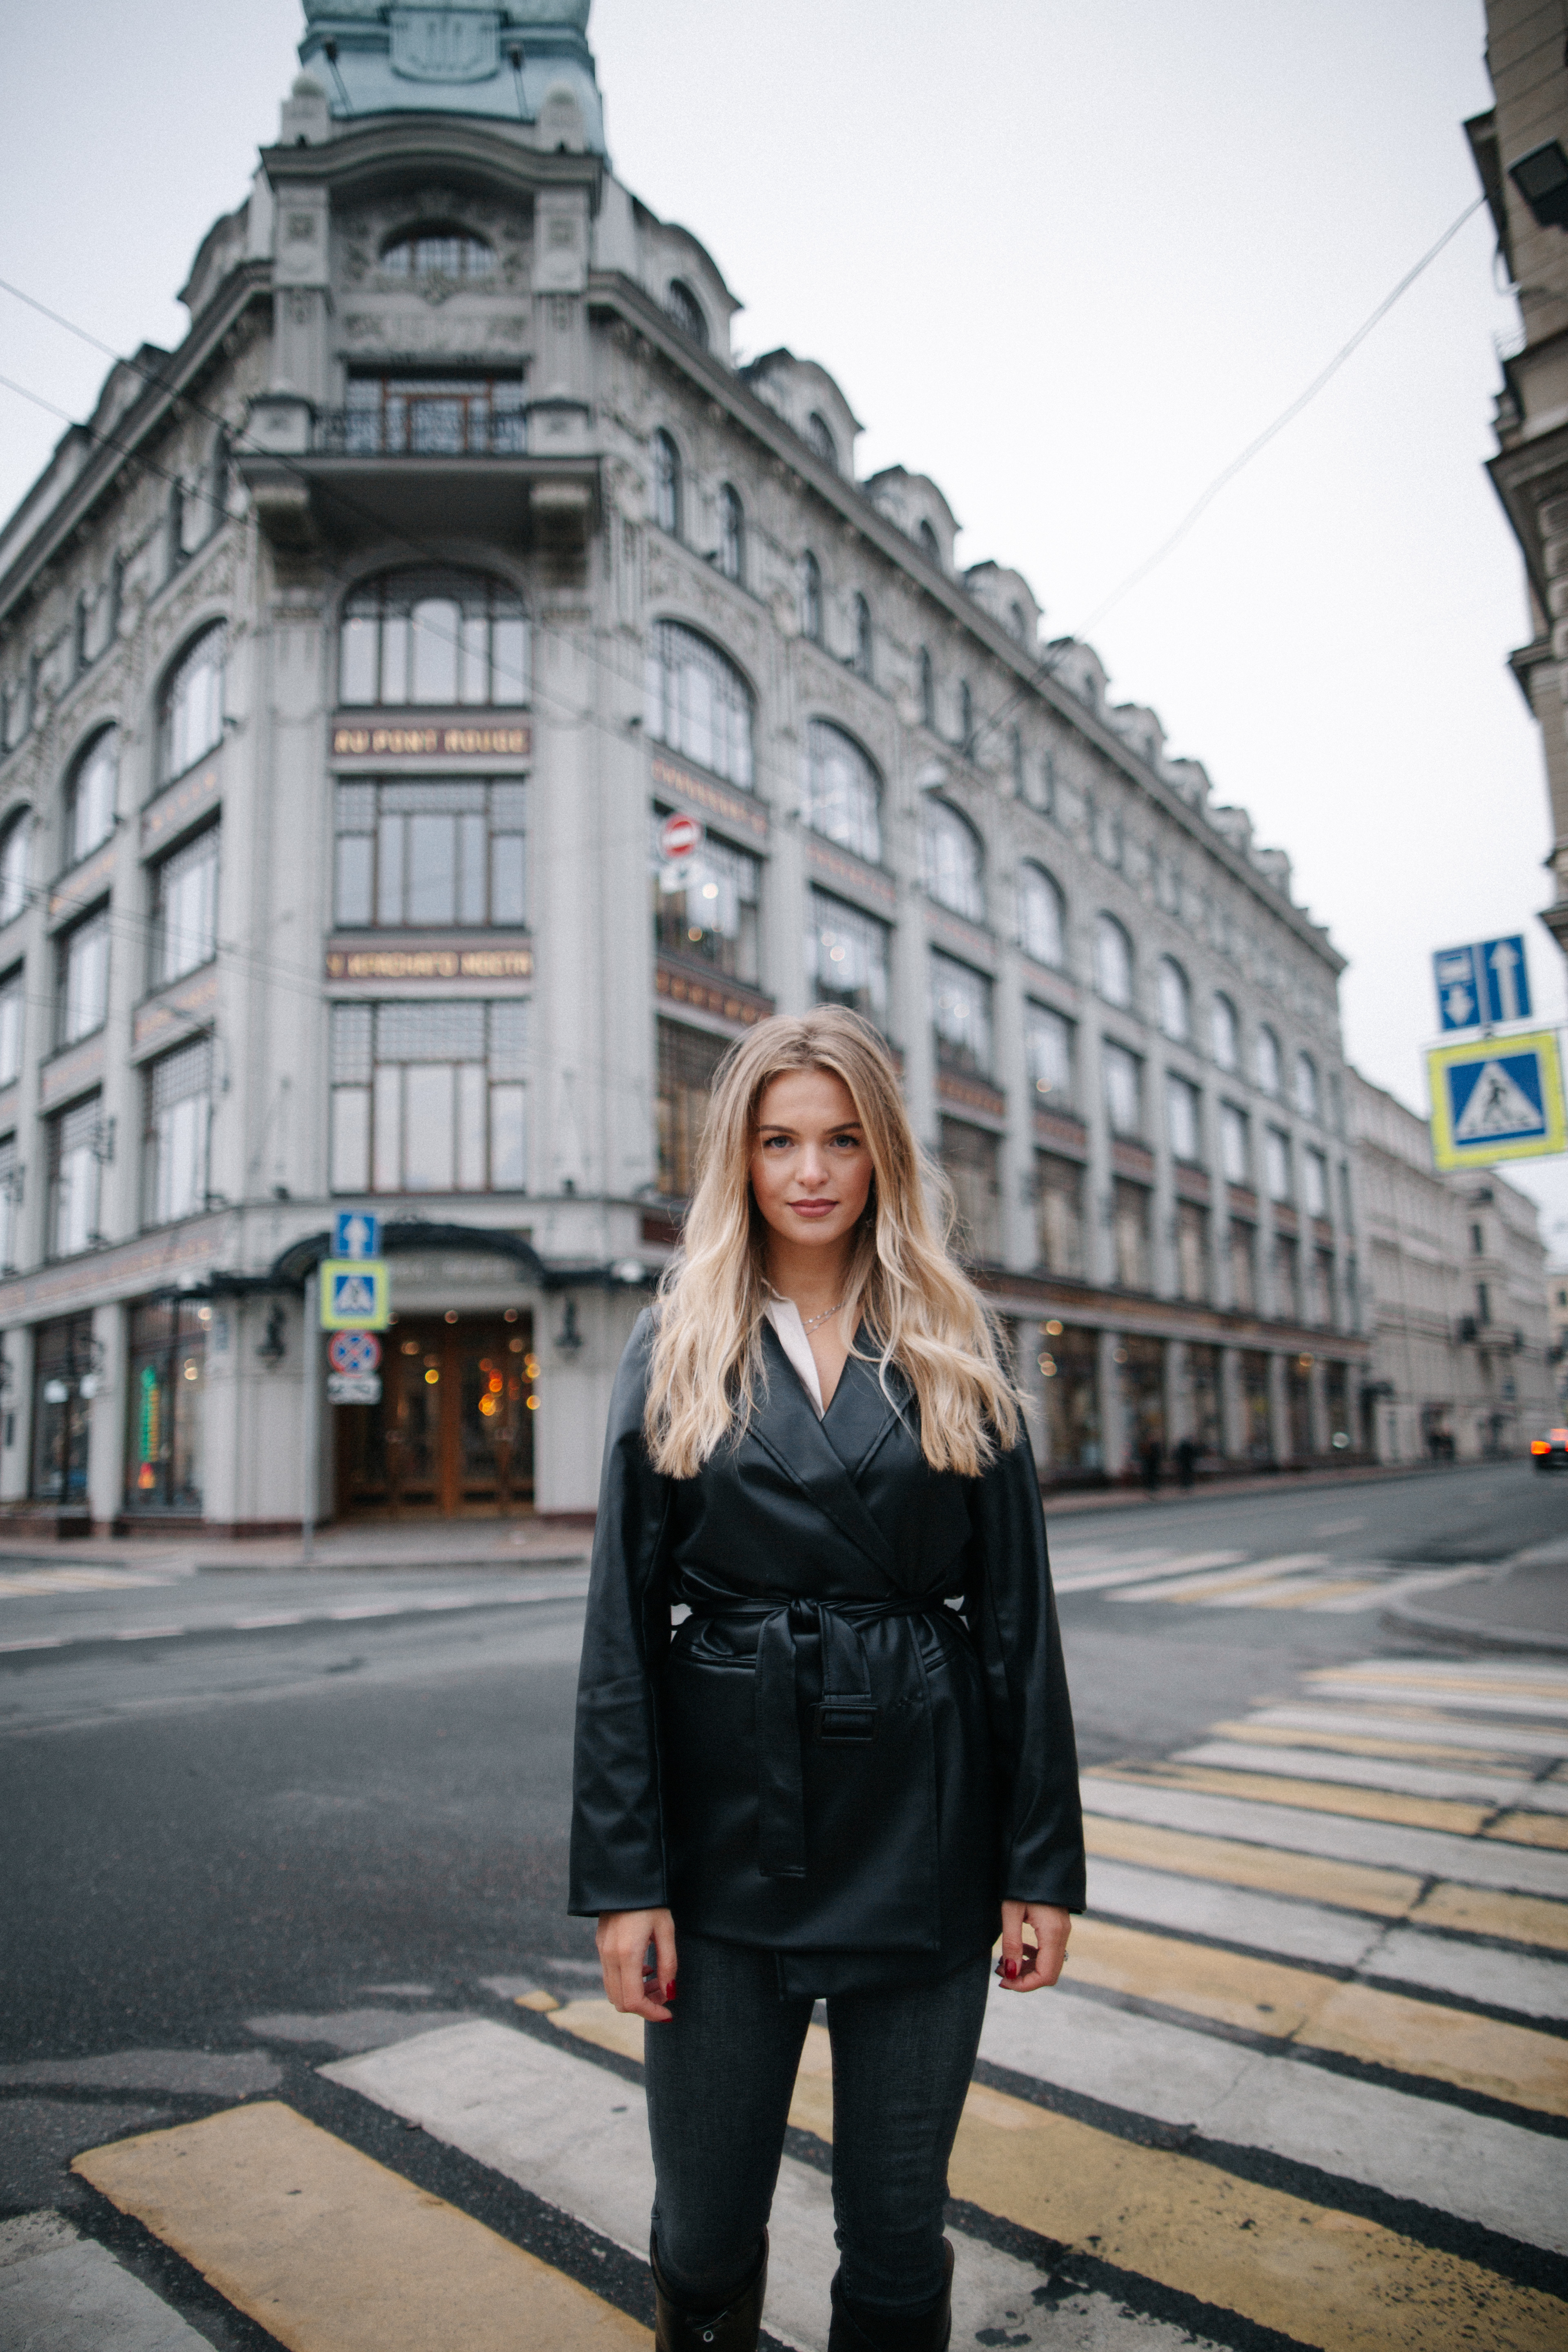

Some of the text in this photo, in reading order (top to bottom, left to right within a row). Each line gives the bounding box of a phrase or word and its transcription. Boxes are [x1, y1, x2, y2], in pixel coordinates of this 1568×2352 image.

[334, 729, 526, 754] AU PONT ROUGE
